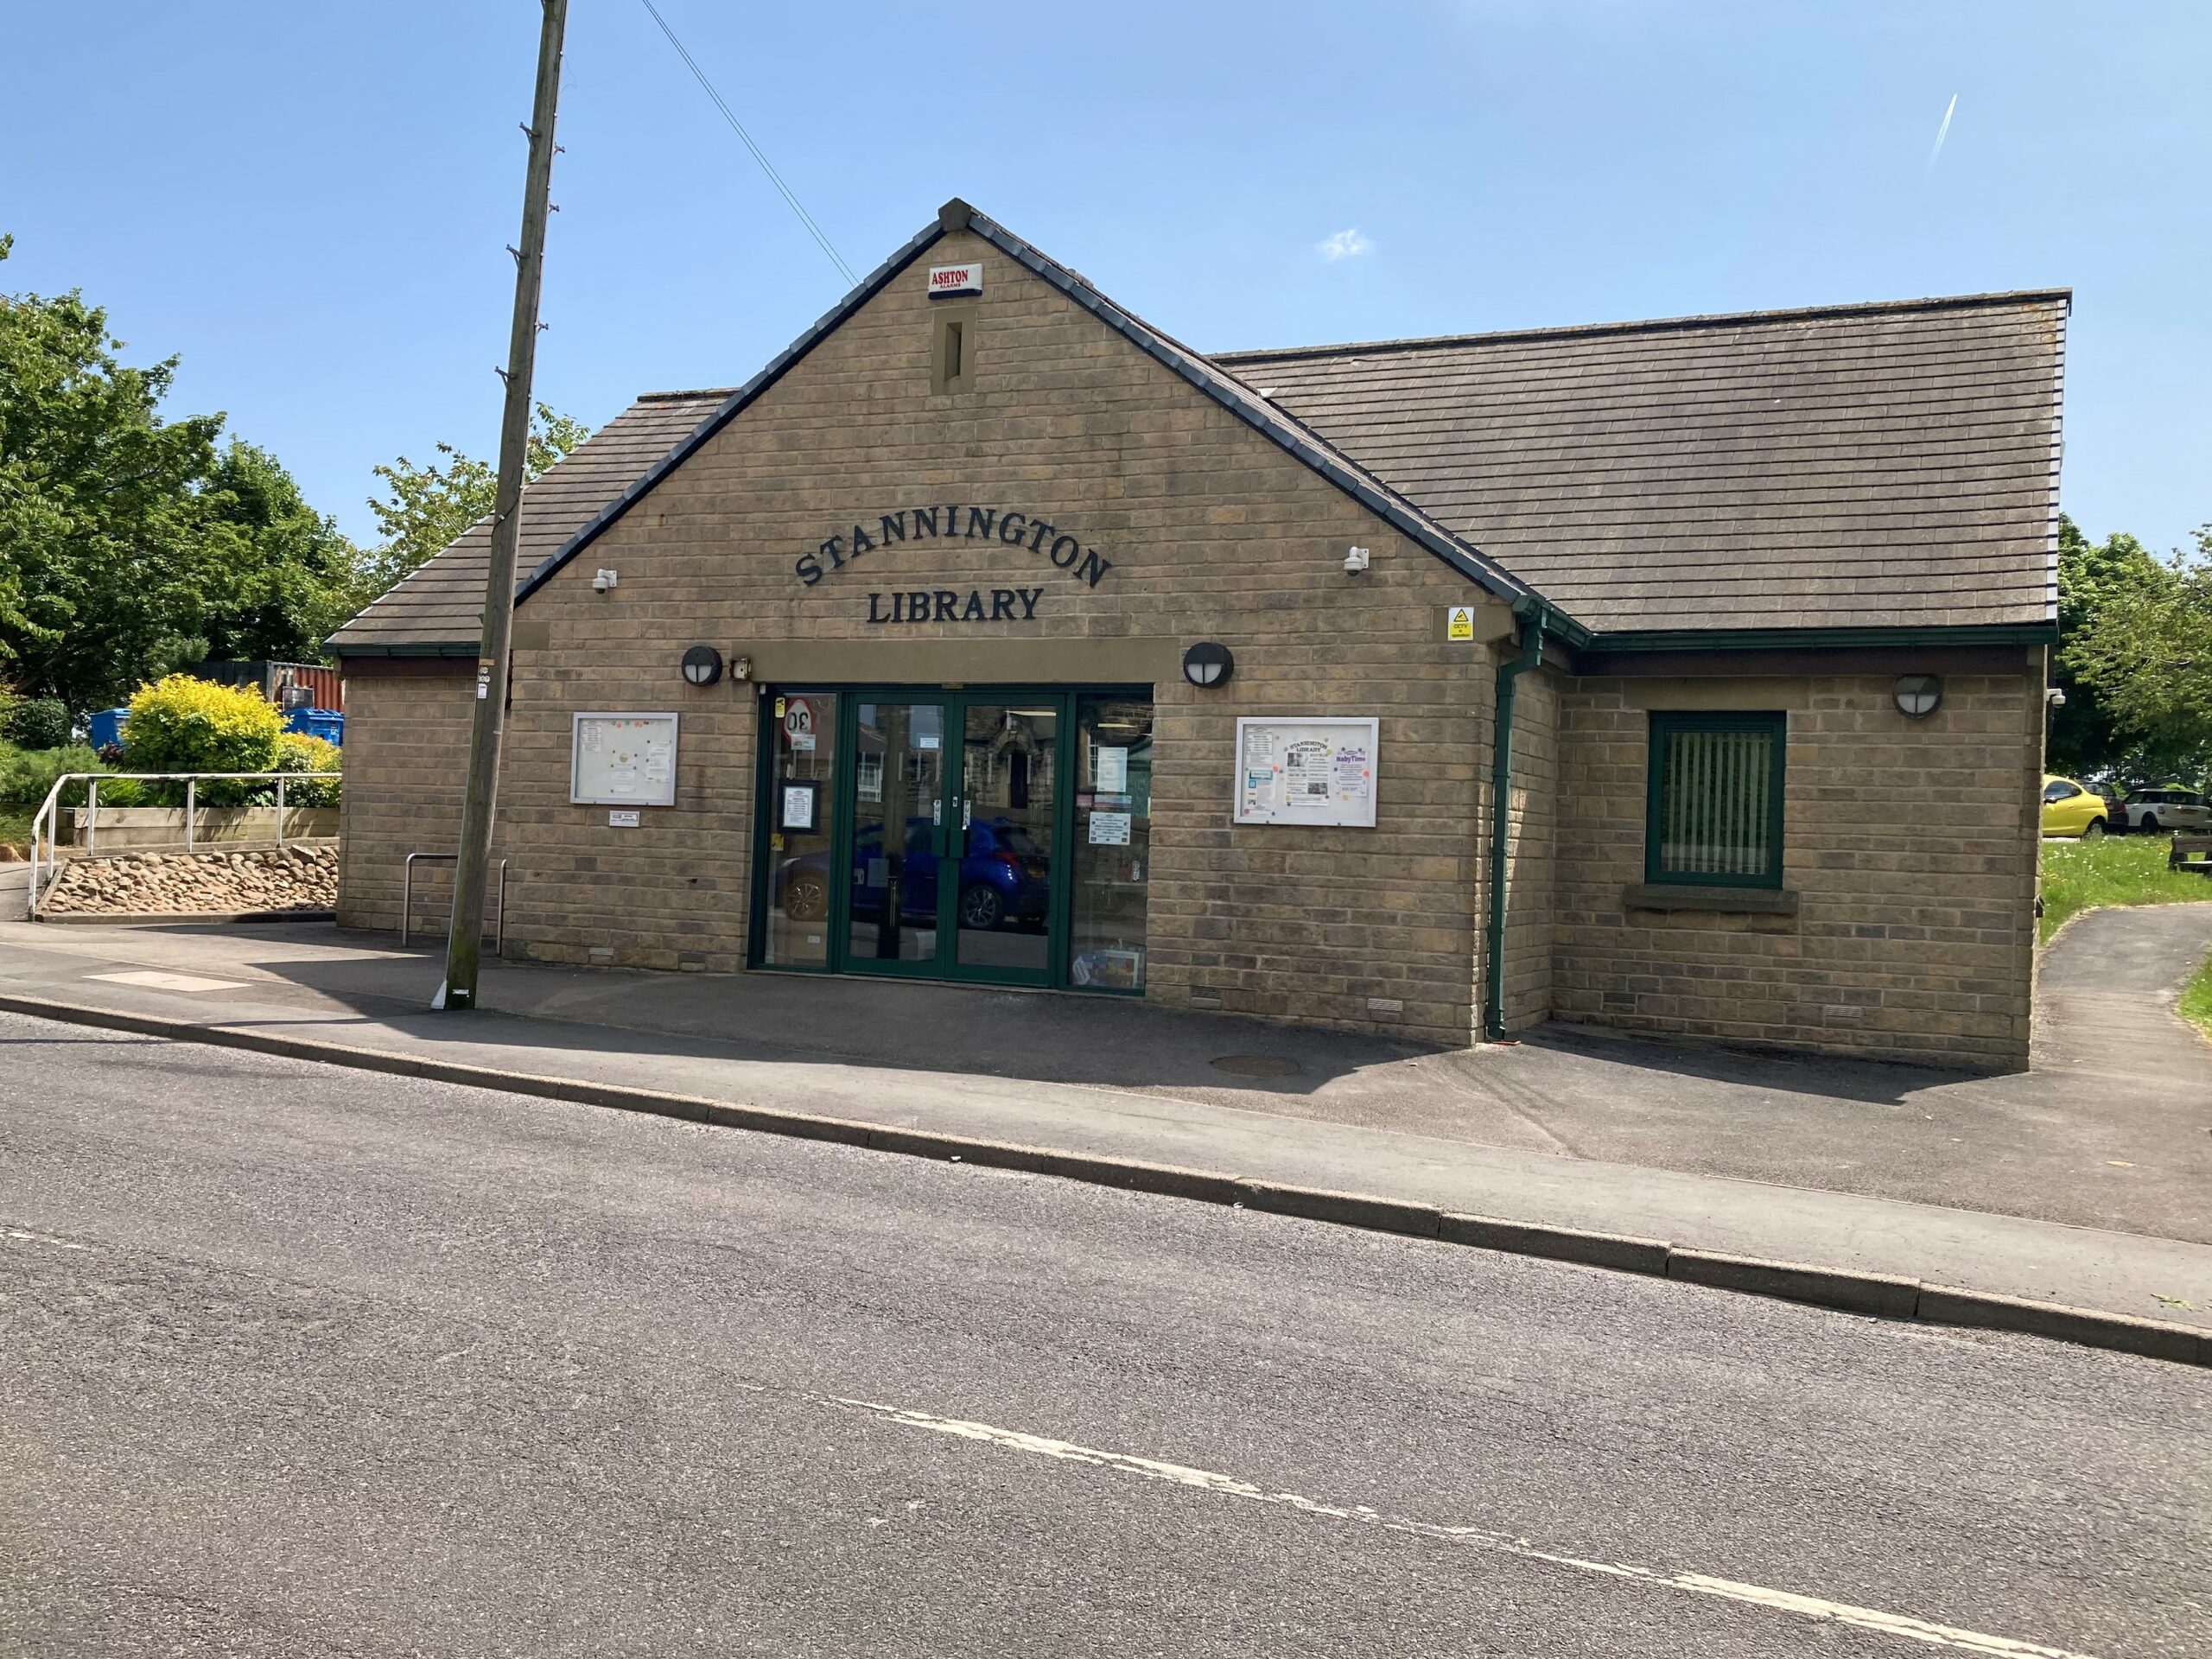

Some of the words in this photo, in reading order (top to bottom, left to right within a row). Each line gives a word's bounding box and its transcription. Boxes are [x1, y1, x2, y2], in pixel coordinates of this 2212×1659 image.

[931, 270, 969, 285] ASHTON
[794, 505, 1112, 588] STANNINGTON
[867, 588, 1045, 623] LIBRARY
